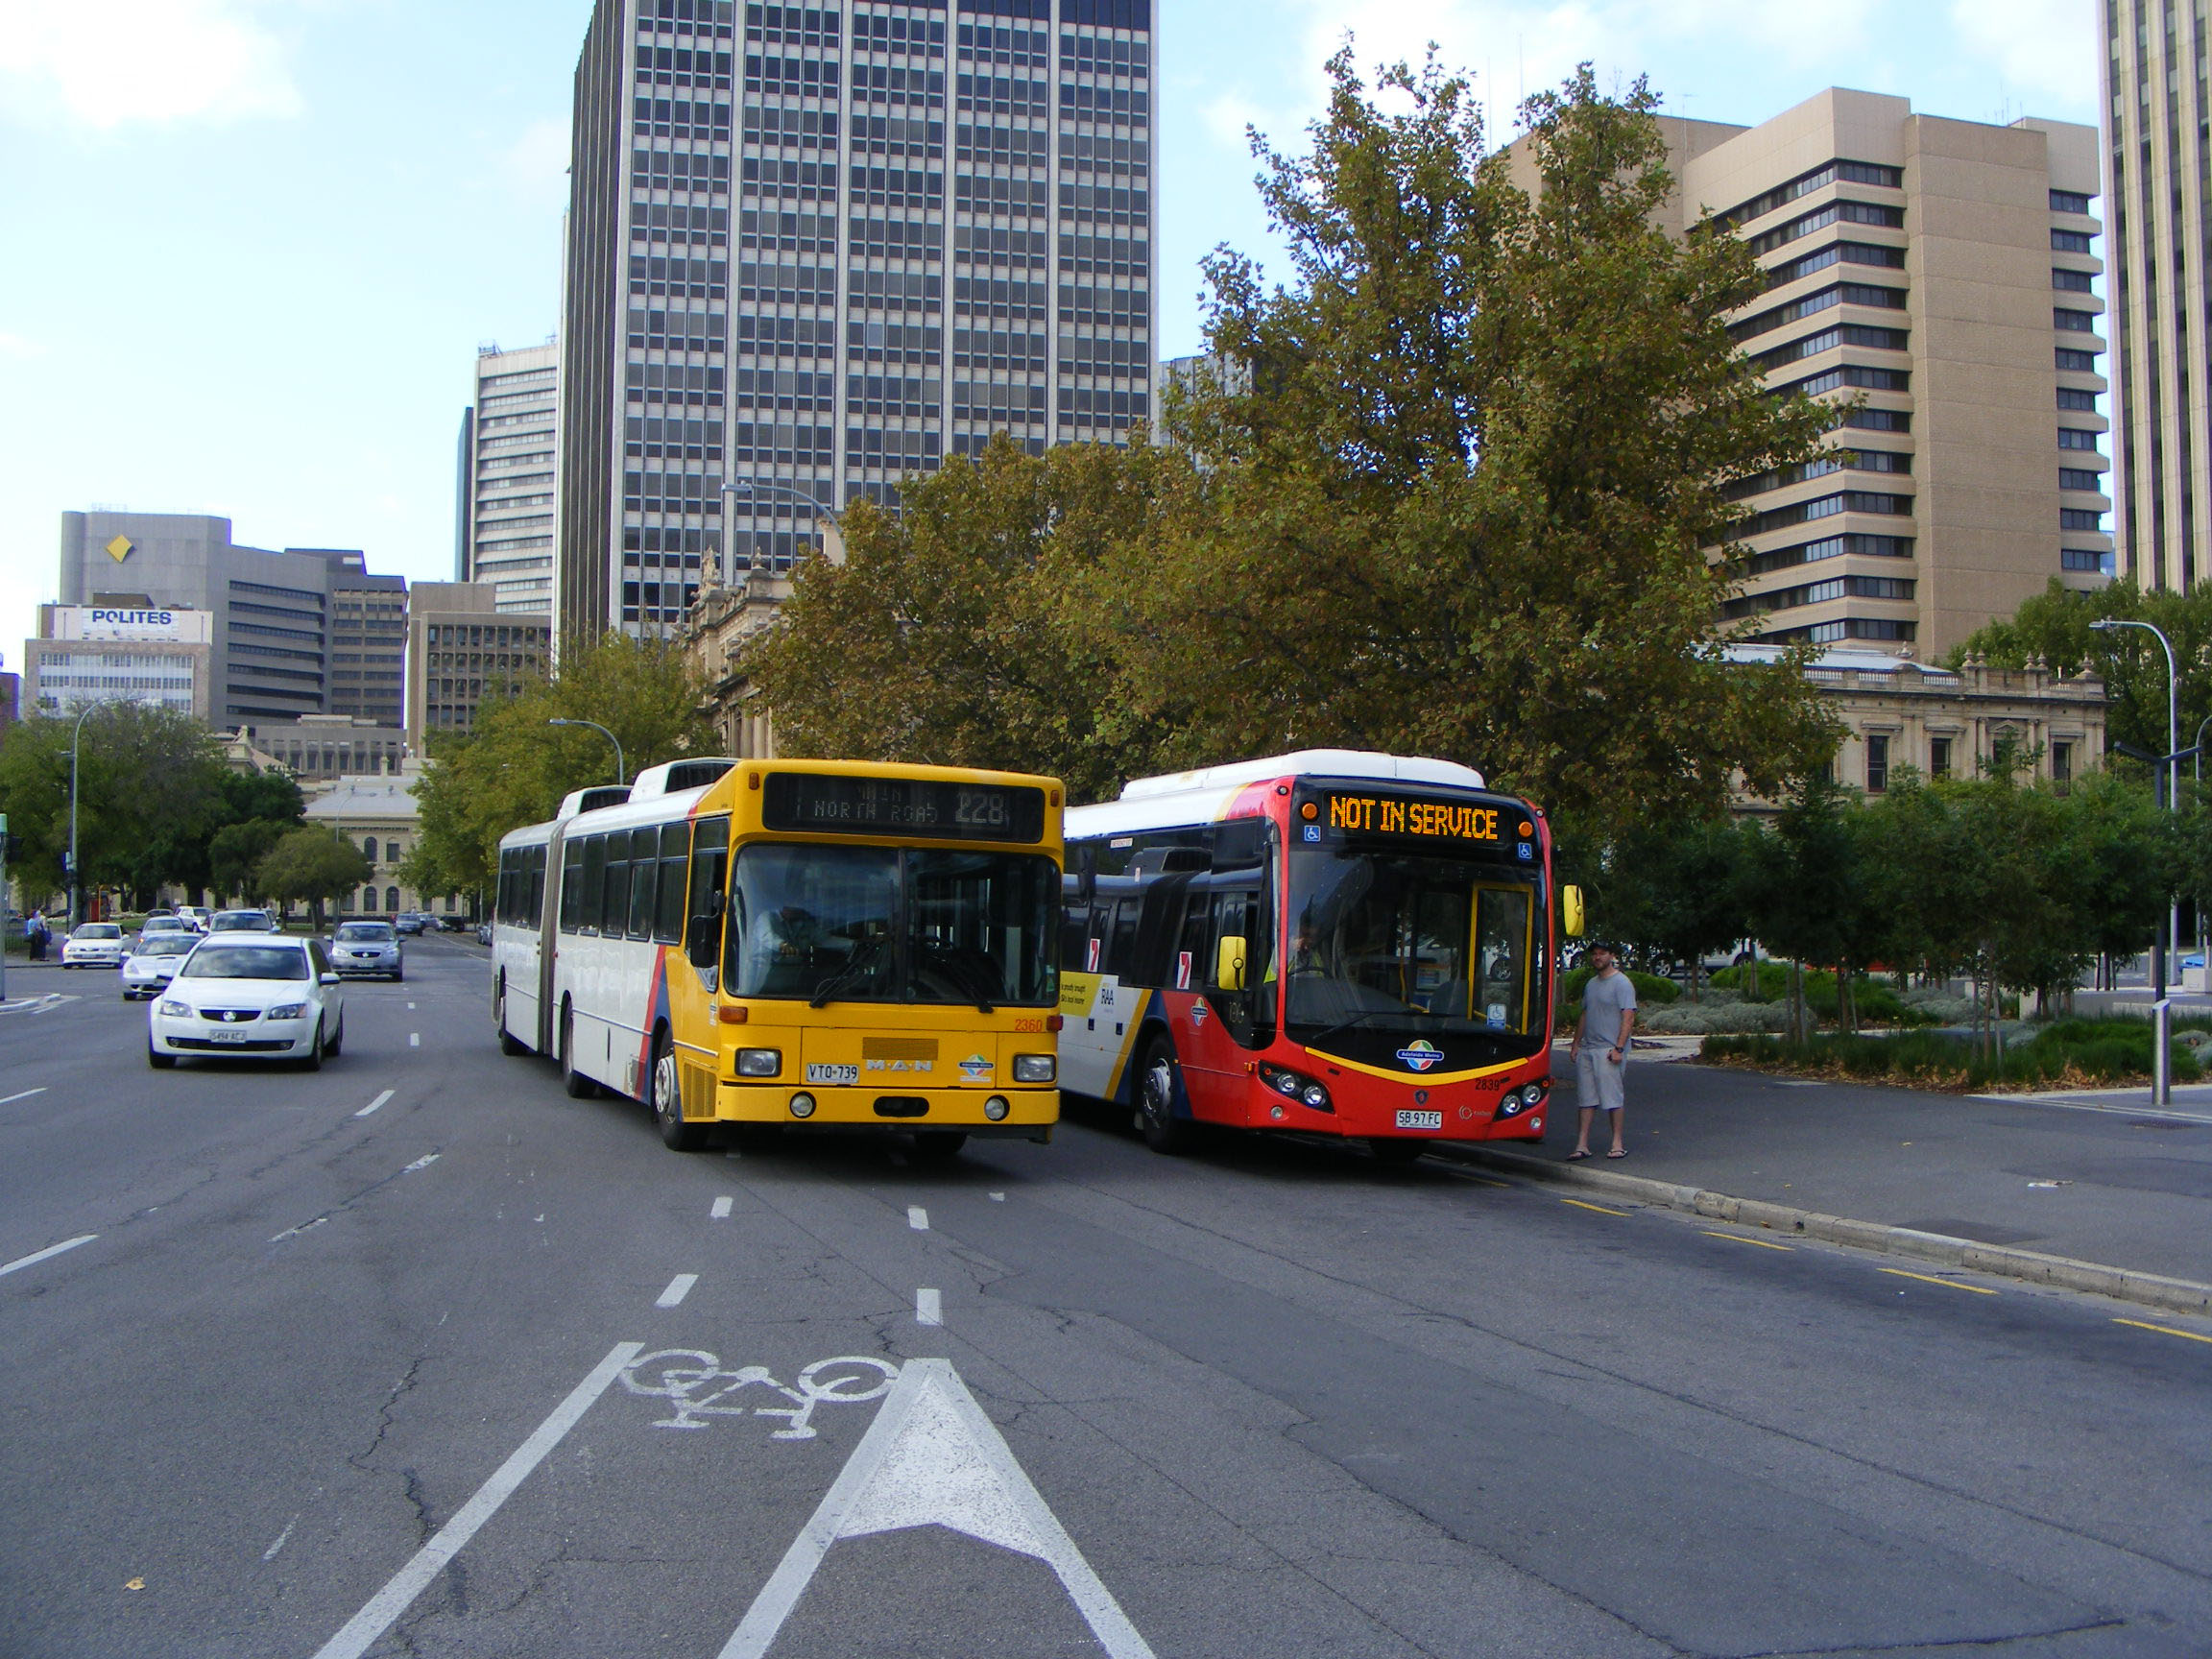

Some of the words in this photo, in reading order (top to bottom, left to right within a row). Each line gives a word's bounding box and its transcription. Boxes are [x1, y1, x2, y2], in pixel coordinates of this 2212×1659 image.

[92, 611, 172, 625] POLITES
[955, 791, 1004, 825] 228
[1331, 796, 1376, 830] NOT
[1380, 800, 1406, 832] IN
[1409, 803, 1499, 840] SERVICE
[1101, 989, 1114, 1005] RAA
[1015, 1019, 1043, 1032] 2360
[1475, 1078, 1500, 1092] 2839
